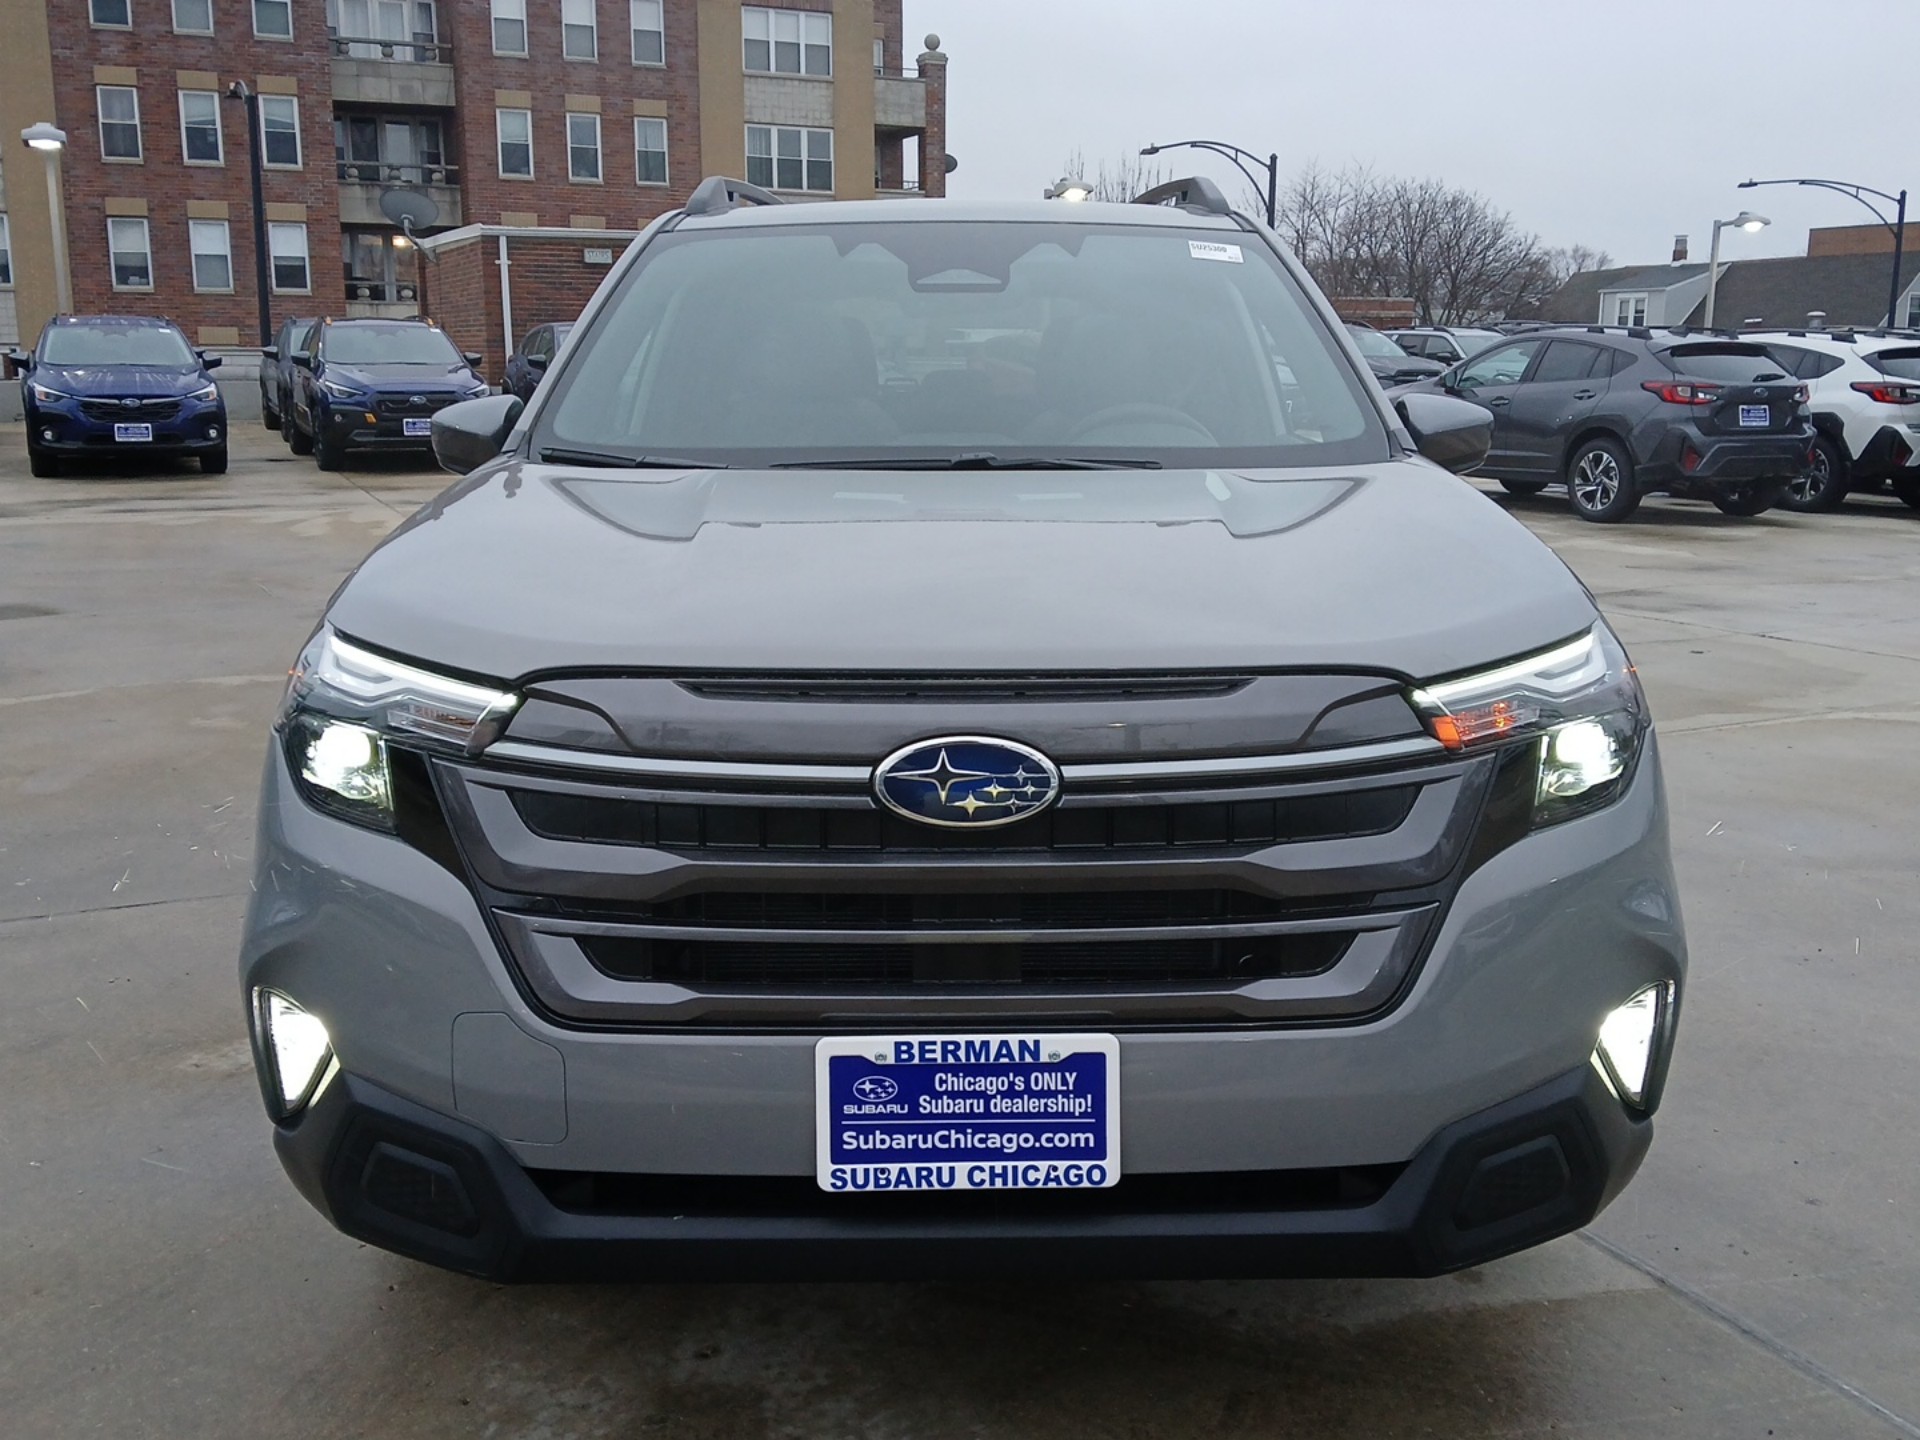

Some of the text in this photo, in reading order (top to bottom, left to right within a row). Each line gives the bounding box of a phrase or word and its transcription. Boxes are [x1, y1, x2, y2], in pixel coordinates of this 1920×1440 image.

[894, 1040, 1041, 1063] BERMAN
[934, 1071, 1077, 1095] Chicago's ONLY
[843, 1103, 909, 1115] SUBARU
[919, 1093, 1092, 1117] Subaru dealership!
[842, 1128, 1095, 1153] SubaruChicago.com
[830, 1164, 1107, 1190] SUBARU CHICAGO
